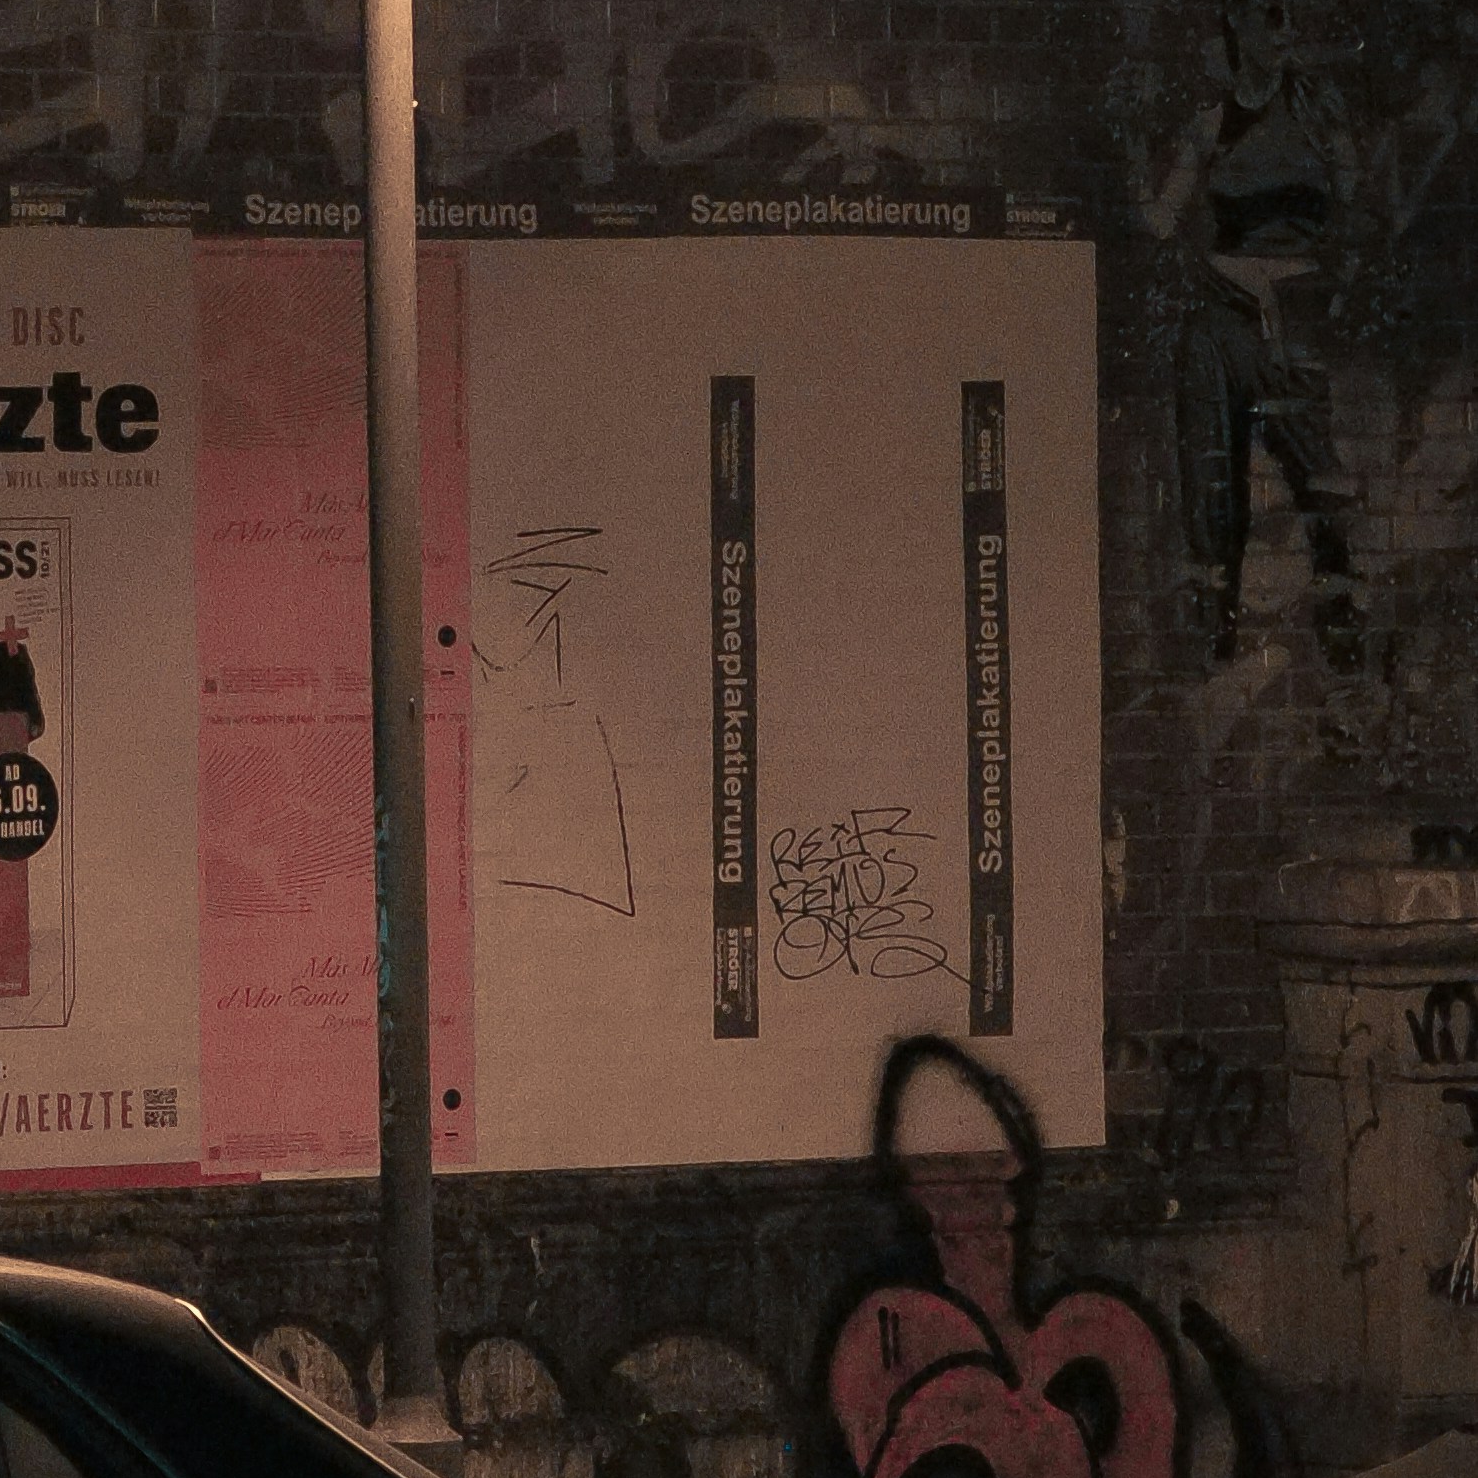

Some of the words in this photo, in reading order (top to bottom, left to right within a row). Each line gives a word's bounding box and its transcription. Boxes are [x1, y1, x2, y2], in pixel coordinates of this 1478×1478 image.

[690, 193, 972, 233] Szeneplakatierung
[11, 306, 86, 346] DISC
[57, 469, 99, 488] MUSS
[716, 540, 748, 884] Szeneplakatierung
[975, 533, 1006, 874] Szeneplakatierung
[0, 819, 45, 838] HANDEL
